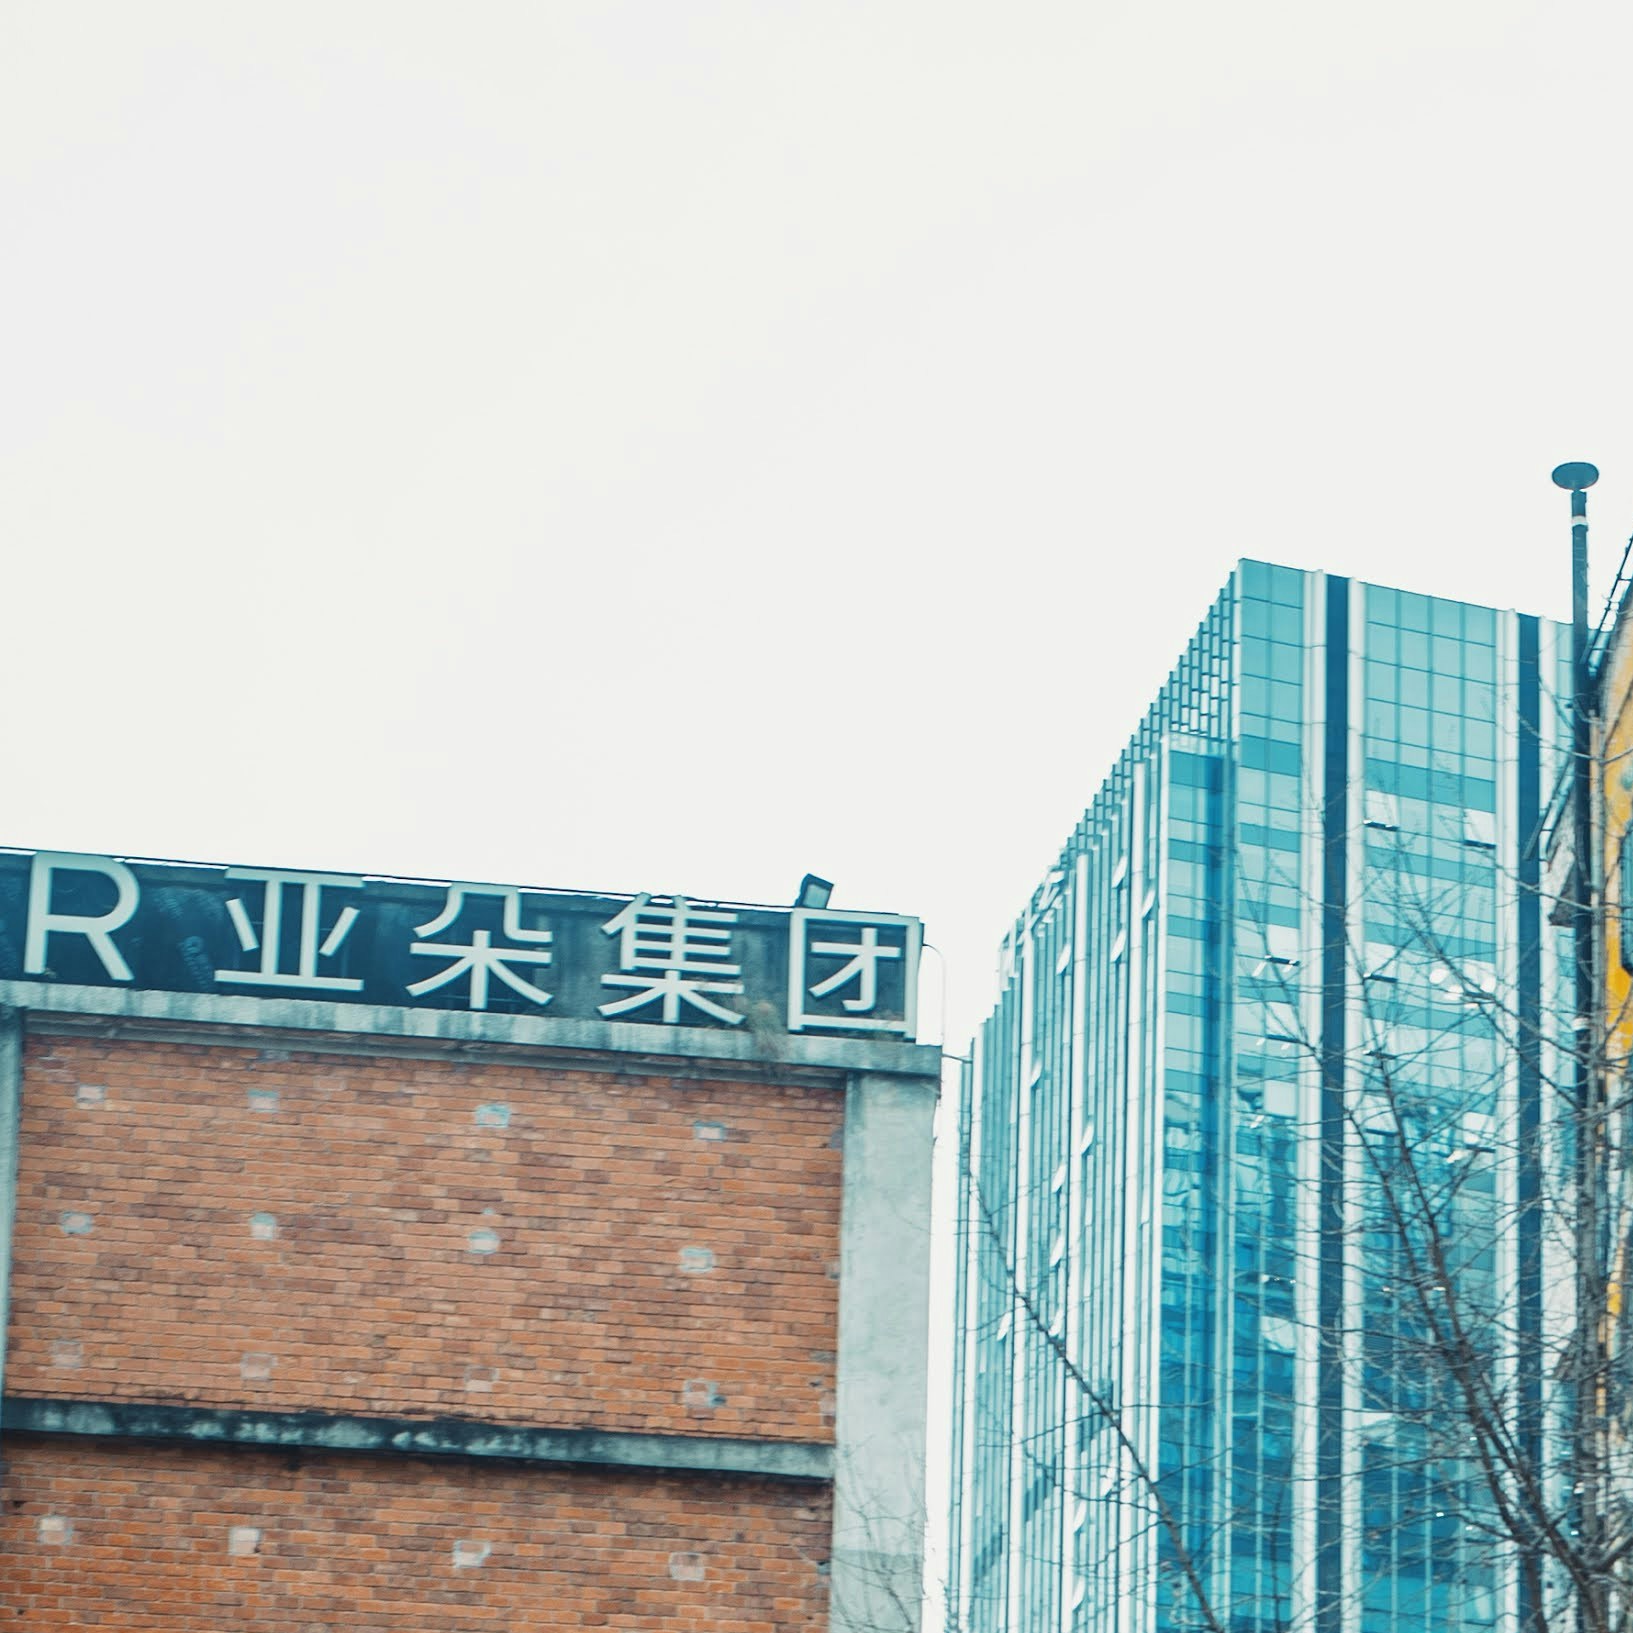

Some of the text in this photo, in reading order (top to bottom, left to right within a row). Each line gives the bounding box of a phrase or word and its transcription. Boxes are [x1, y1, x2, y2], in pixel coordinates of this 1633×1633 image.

[24, 852, 922, 1039] R 亚朵集团
